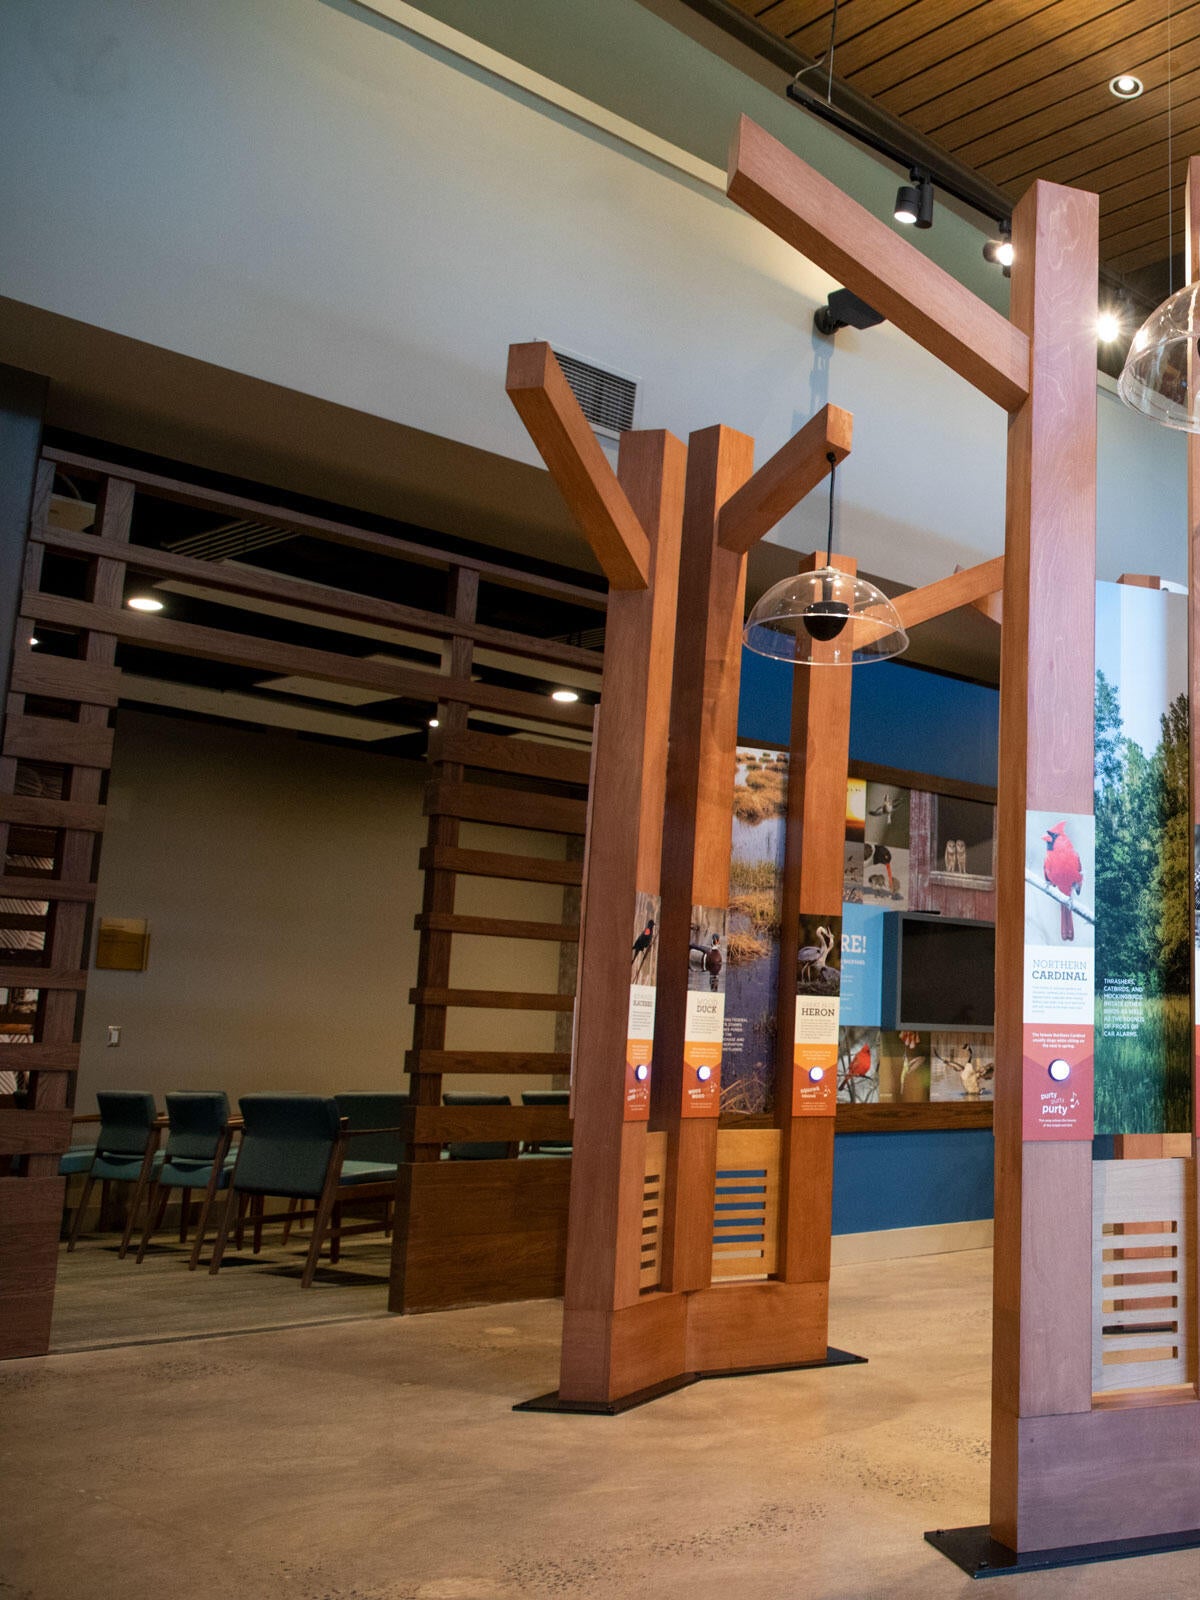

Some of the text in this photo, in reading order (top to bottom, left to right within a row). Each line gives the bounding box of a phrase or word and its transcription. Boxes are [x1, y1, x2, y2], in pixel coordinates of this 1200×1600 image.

[1032, 959, 1087, 970] NORTHERN
[1032, 970, 1087, 981] CARDINAL
[696, 1004, 717, 1014] DUCK
[801, 1007, 835, 1017] HERON
[1041, 1091, 1057, 1100] purty
[1042, 1104, 1067, 1116] purty
